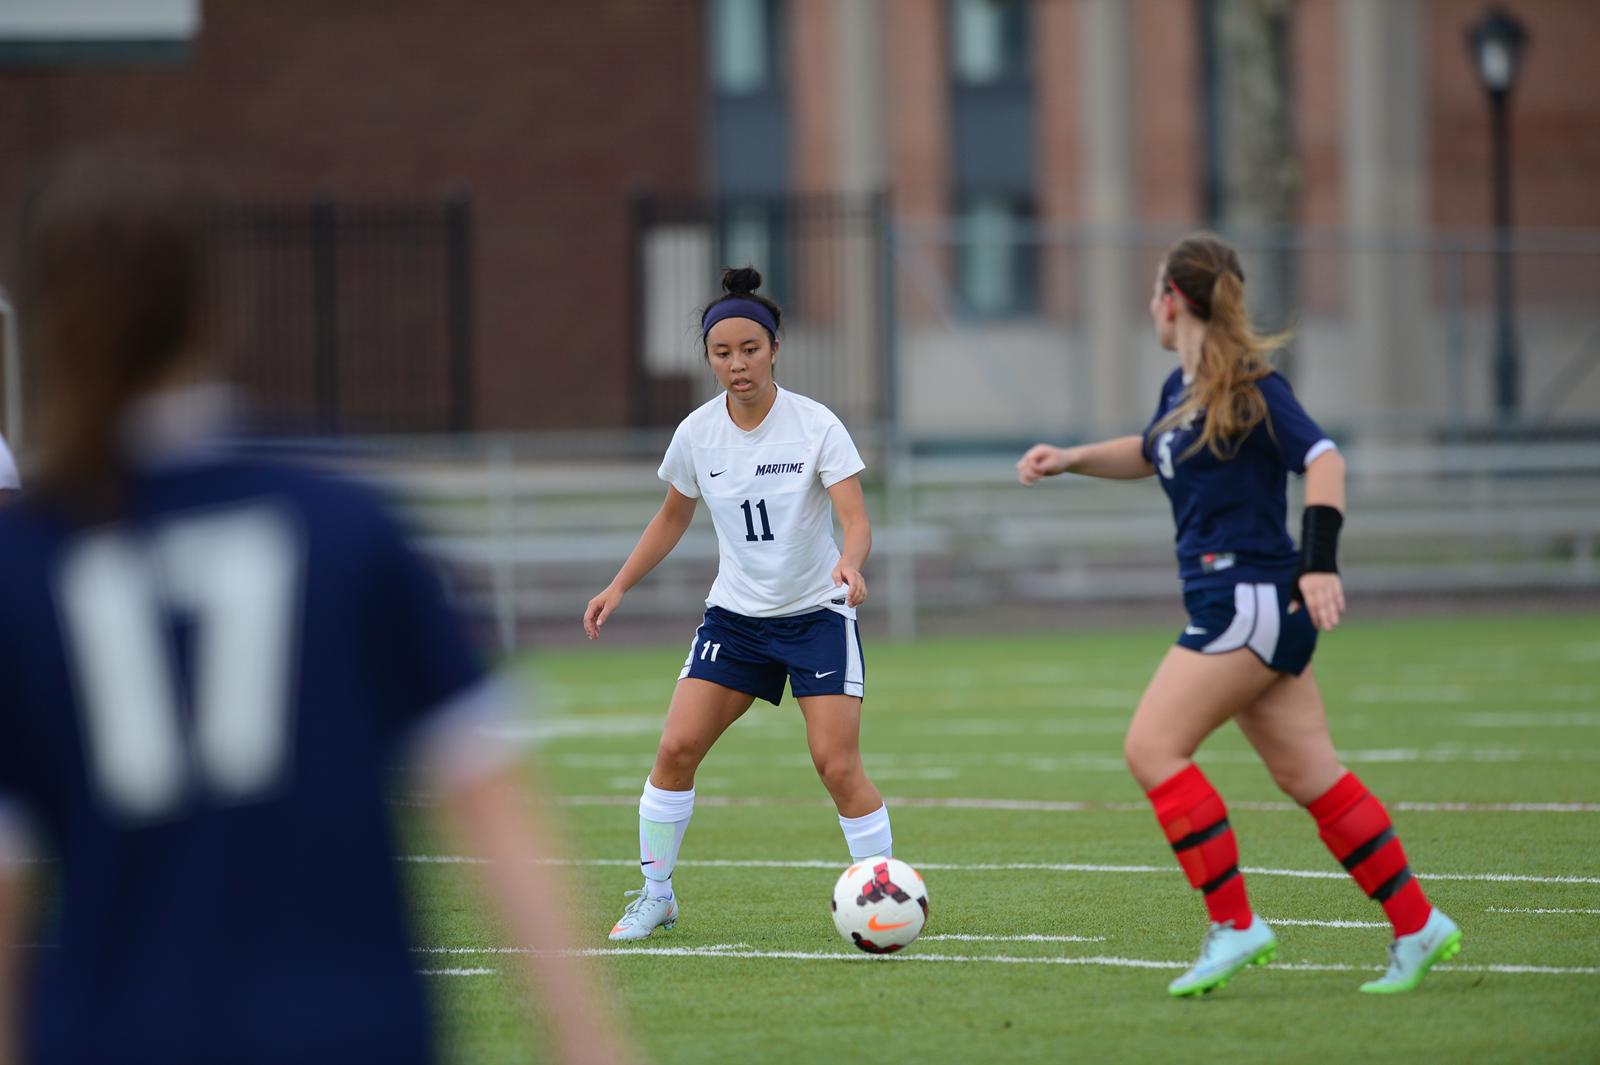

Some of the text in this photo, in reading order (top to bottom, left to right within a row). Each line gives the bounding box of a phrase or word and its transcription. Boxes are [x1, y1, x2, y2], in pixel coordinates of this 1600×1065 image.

[755, 462, 804, 476] MARITIME
[740, 499, 774, 541] 11
[57, 505, 300, 820] 17
[700, 641, 720, 662] 11
